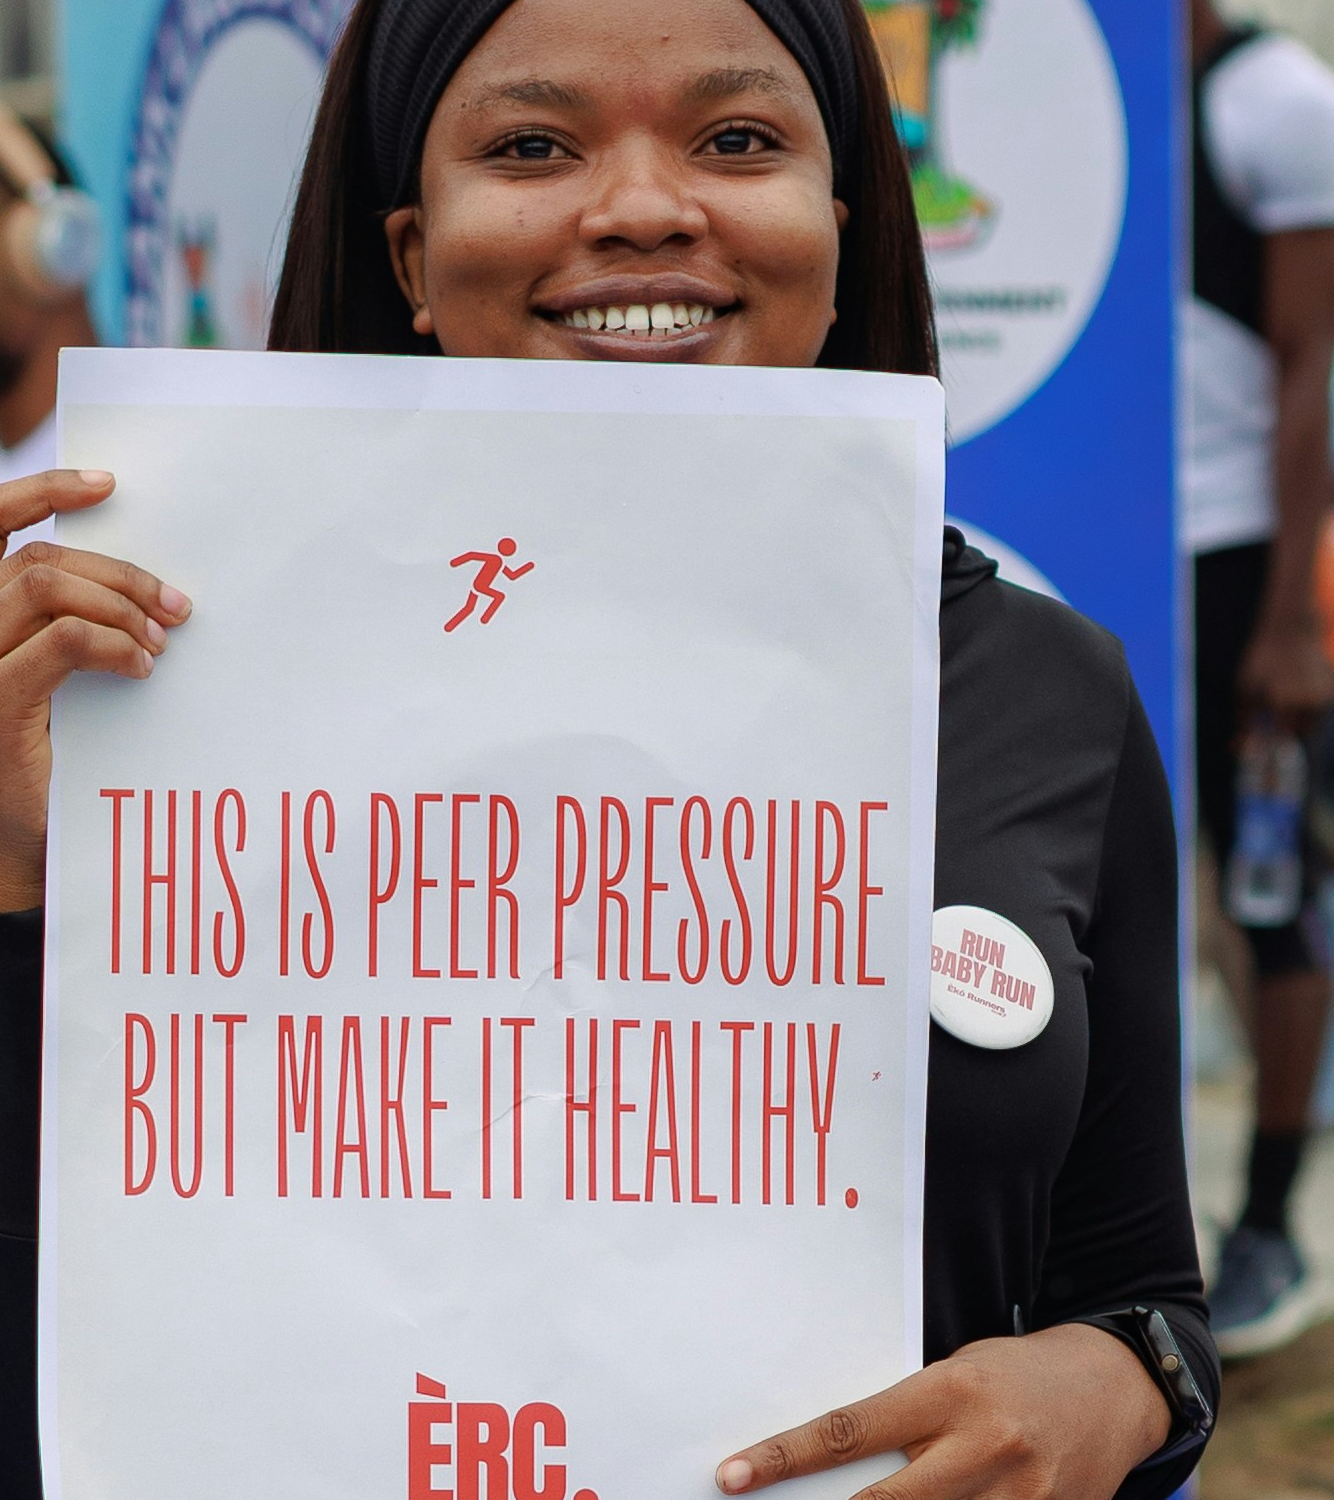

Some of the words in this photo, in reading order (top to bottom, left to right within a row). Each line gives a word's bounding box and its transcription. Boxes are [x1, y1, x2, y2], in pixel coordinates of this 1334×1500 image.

[100, 788, 247, 980] THIS
[279, 790, 336, 980] IS
[367, 792, 520, 980] PEER
[553, 794, 890, 987] PRESSURE
[931, 945, 987, 989] BABY
[990, 969, 1036, 1011] RUN
[960, 928, 1006, 969] RUN
[967, 992, 1006, 1014] Runners
[124, 1013, 248, 1199] BUT
[277, 1014, 453, 1200] MAKE
[481, 1016, 536, 1200] IT
[565, 1017, 860, 1209] HEALTHY.
